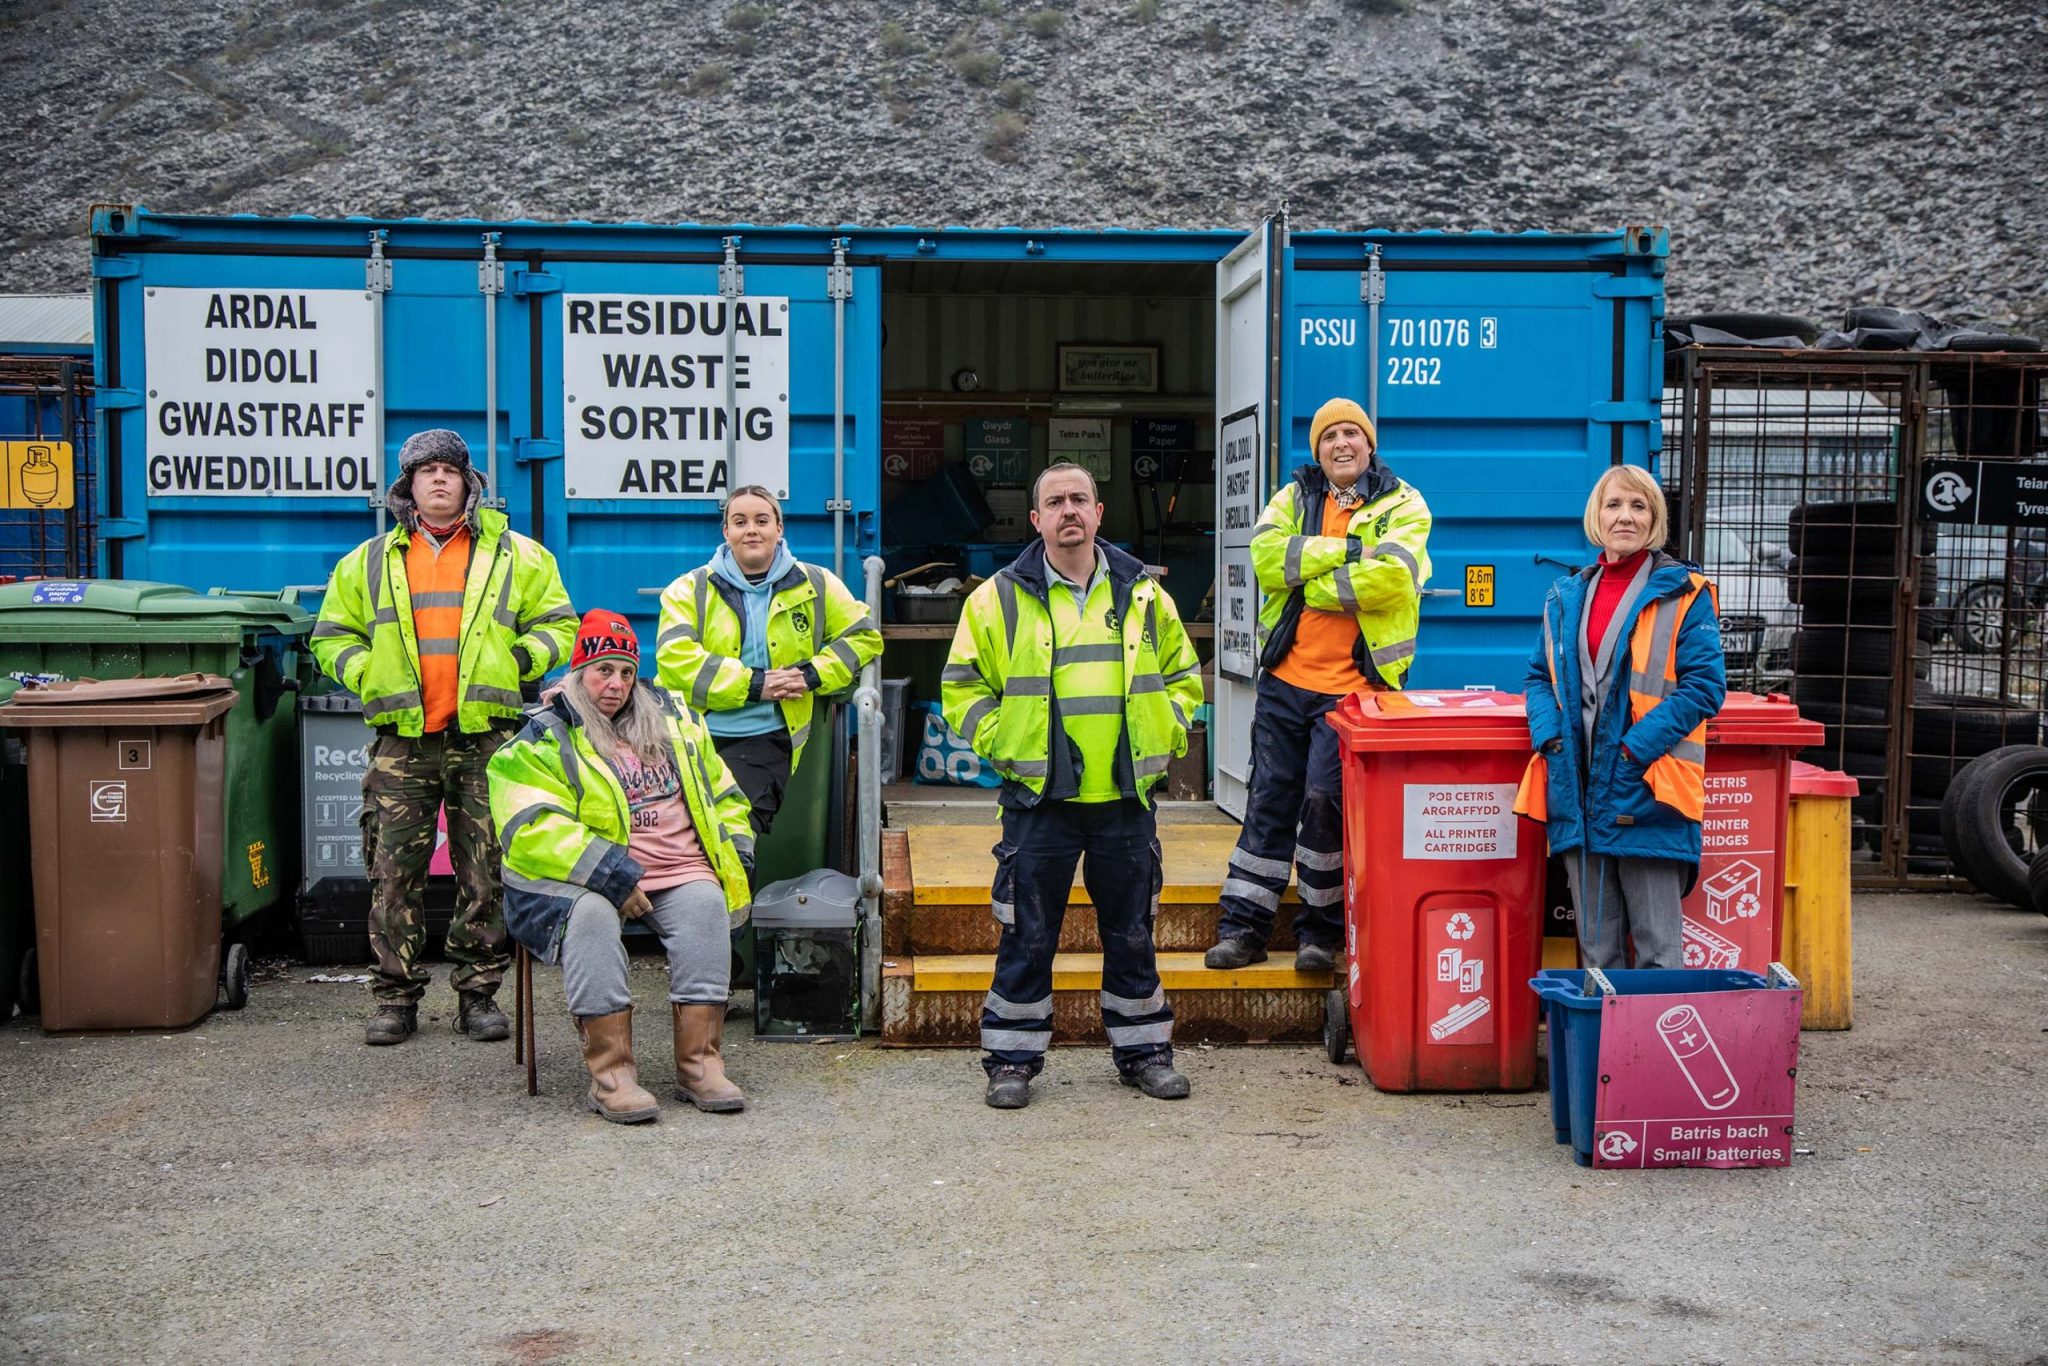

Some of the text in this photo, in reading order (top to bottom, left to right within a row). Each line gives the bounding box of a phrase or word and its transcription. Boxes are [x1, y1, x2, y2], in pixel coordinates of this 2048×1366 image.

[205, 293, 317, 329] ARDAL
[568, 300, 783, 337] RESIDUAL
[1300, 318, 1495, 347] PSSU 701076 3
[205, 348, 317, 383] DIDOLI
[602, 353, 751, 389] WASTE
[1387, 357, 1441, 386] 22G2
[159, 401, 365, 437] GWASTRAFF
[580, 405, 774, 442] SORTING
[982, 421, 1012, 432] Gwydr
[1059, 430, 1080, 439] Tetra
[1148, 422, 1177, 433] Papur
[984, 435, 1011, 445] Glass
[1148, 436, 1177, 448] Paper
[149, 454, 377, 491] GWEDDILLIOL
[618, 459, 728, 494] AREA
[128, 749, 138, 763] 3
[1703, 776, 1748, 788] CETRIS
[1429, 791, 1494, 801] POB CETRIS
[631, 810, 659, 827] 982
[1422, 806, 1501, 816] ARGRAFFYDD
[1424, 829, 1497, 839] ALL PRINTER
[1424, 843, 1497, 853] CARTRIDGES
[1670, 1124, 1768, 1140] Batris bach
[1653, 1145, 1782, 1162] Small batteries
